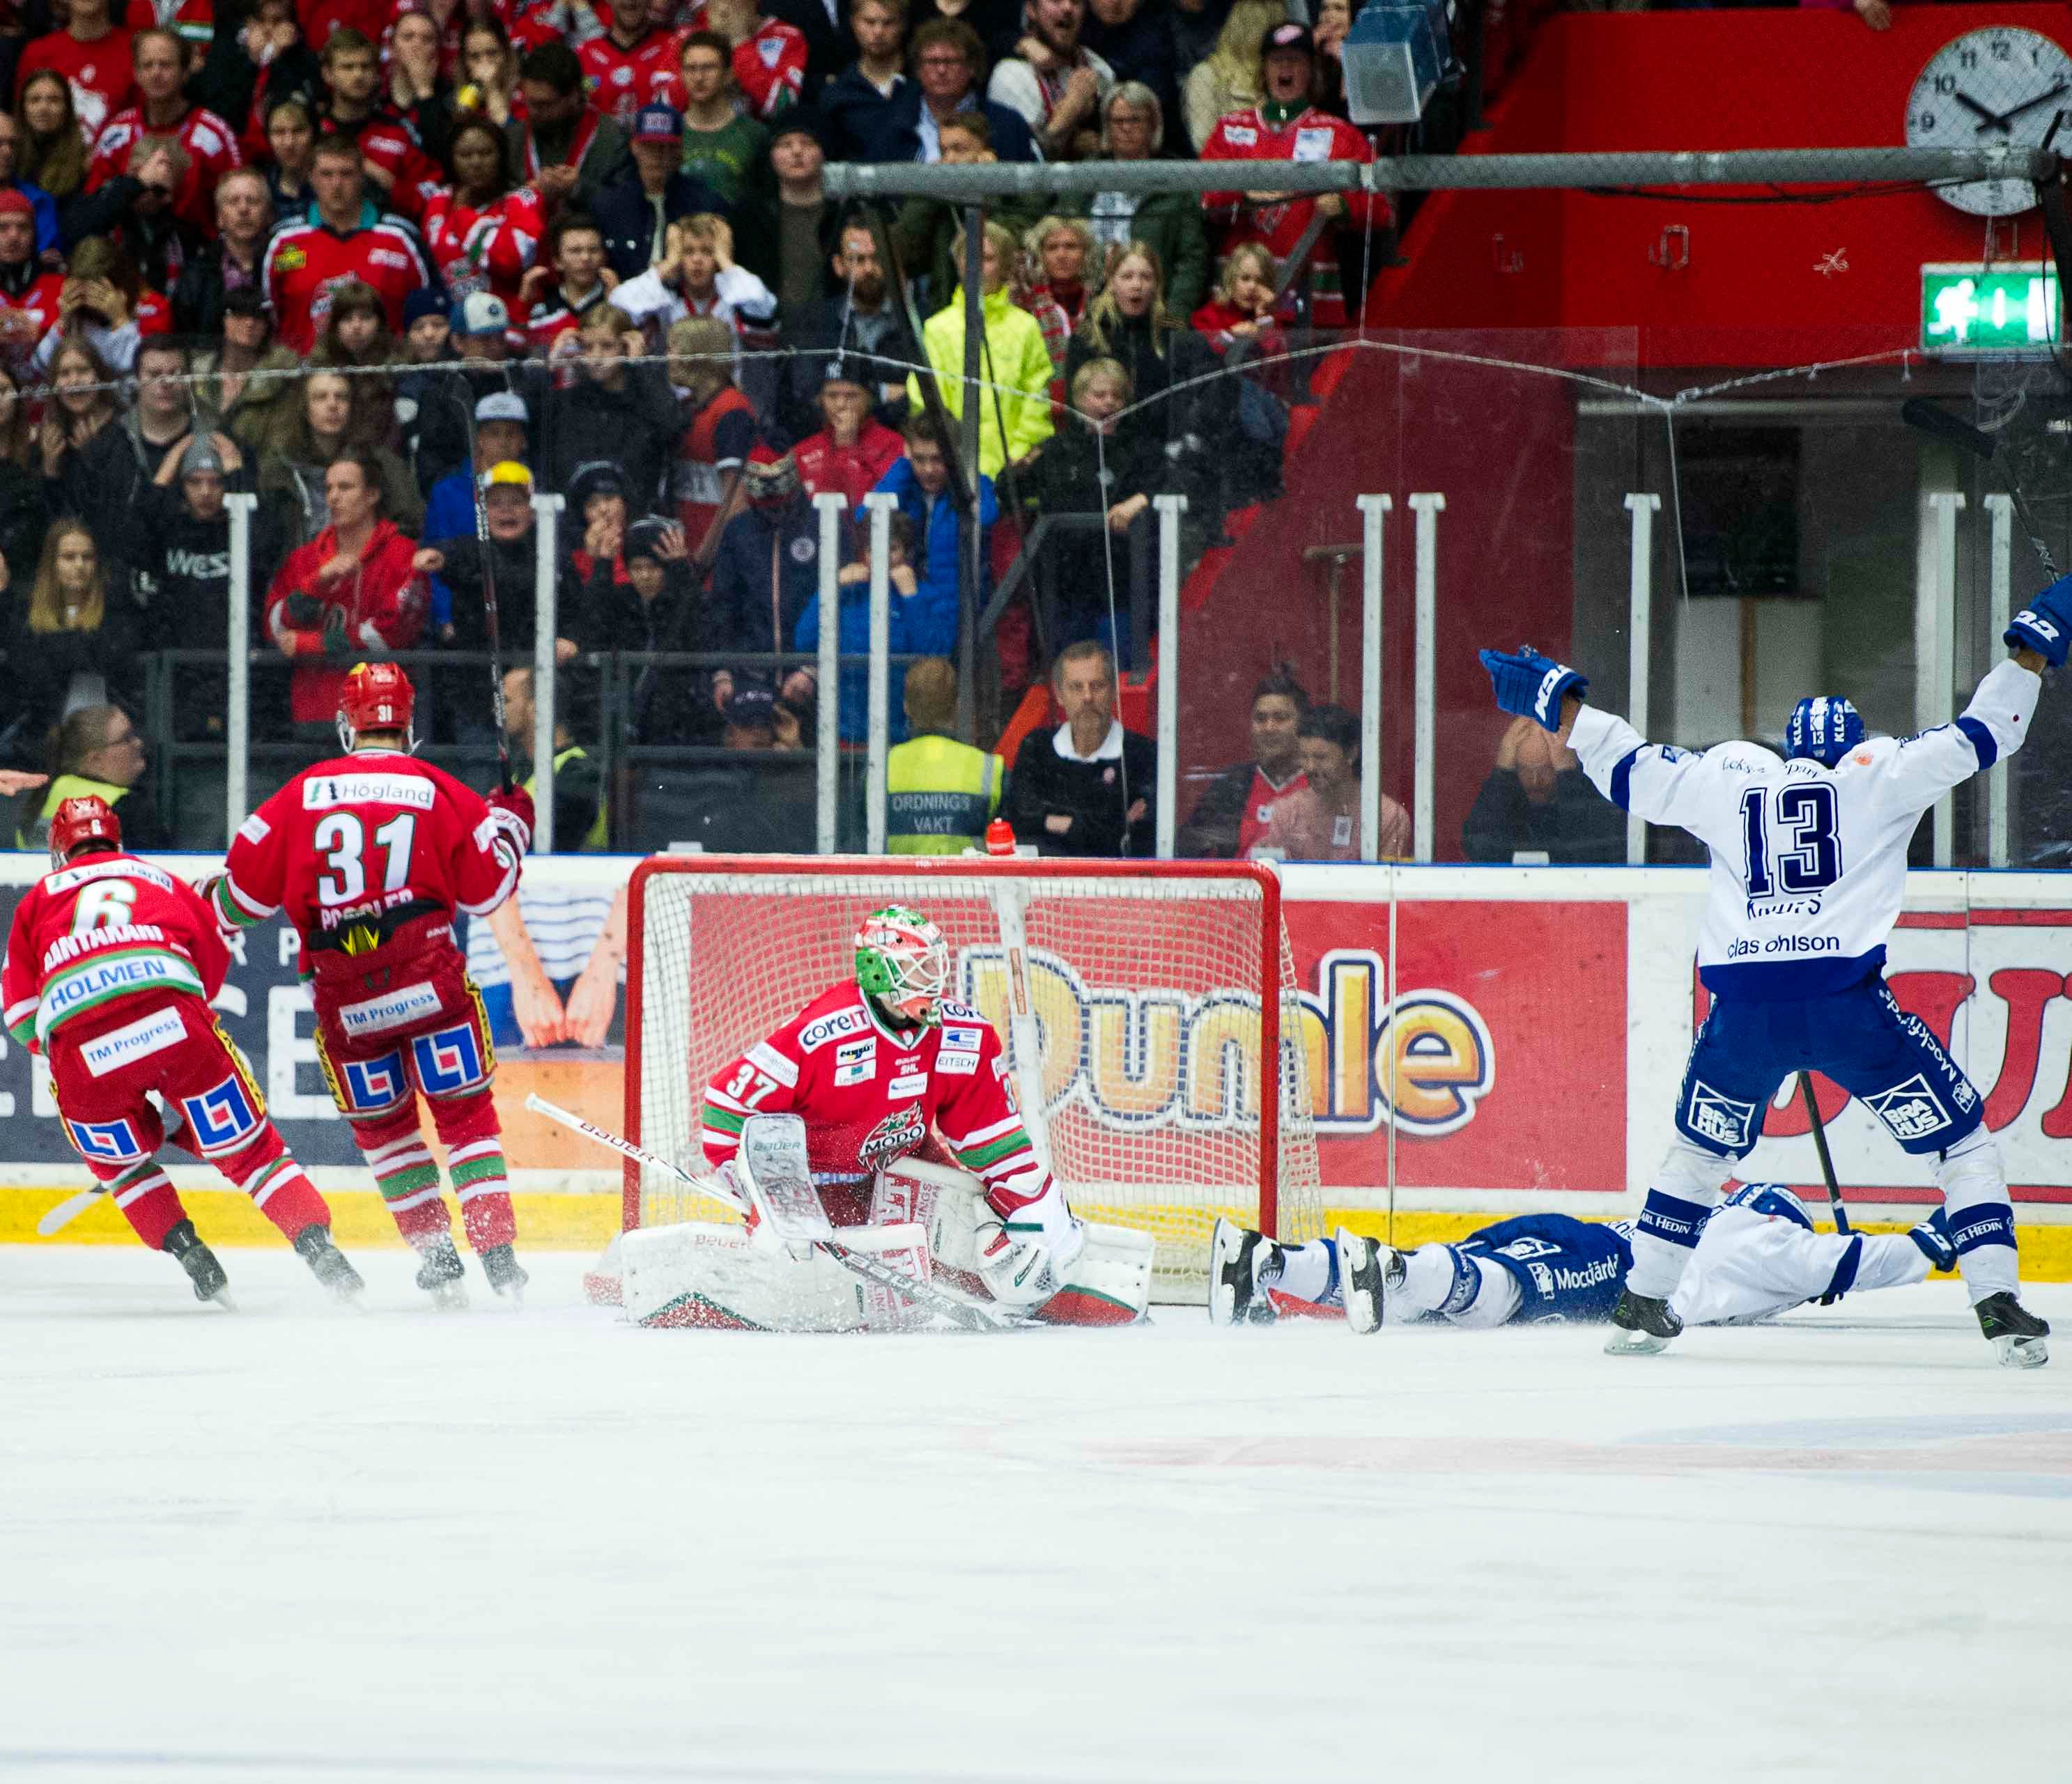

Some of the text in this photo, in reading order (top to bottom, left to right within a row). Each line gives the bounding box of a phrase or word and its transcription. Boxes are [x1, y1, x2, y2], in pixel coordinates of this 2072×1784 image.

[1961, 49, 1977, 68] 11
[1934, 73, 1956, 95] 10
[343, 783, 431, 803] Högland
[892, 793, 970, 811] ORDNINGS
[913, 816, 953, 832] VAKT
[1740, 781, 1843, 899] 13
[314, 811, 417, 907] 31
[70, 878, 137, 938] 6
[1728, 934, 1840, 958] clas ohlson
[51, 959, 167, 1011] HOLMEN
[345, 994, 435, 1025] TM Progress
[88, 1018, 180, 1064] TM Progress
[961, 947, 1493, 1134] Dumle
[727, 1064, 778, 1109] 37
[1699, 1102, 1739, 1128] BRA
[1882, 1098, 1931, 1124] BRA
[1893, 1110, 1939, 1136] HUS
[865, 1126, 922, 1154] MODO
[1697, 1117, 1740, 1144] HUS
[1655, 1216, 1692, 1234] HEDIN
[1967, 1221, 2004, 1239] HEDIN
